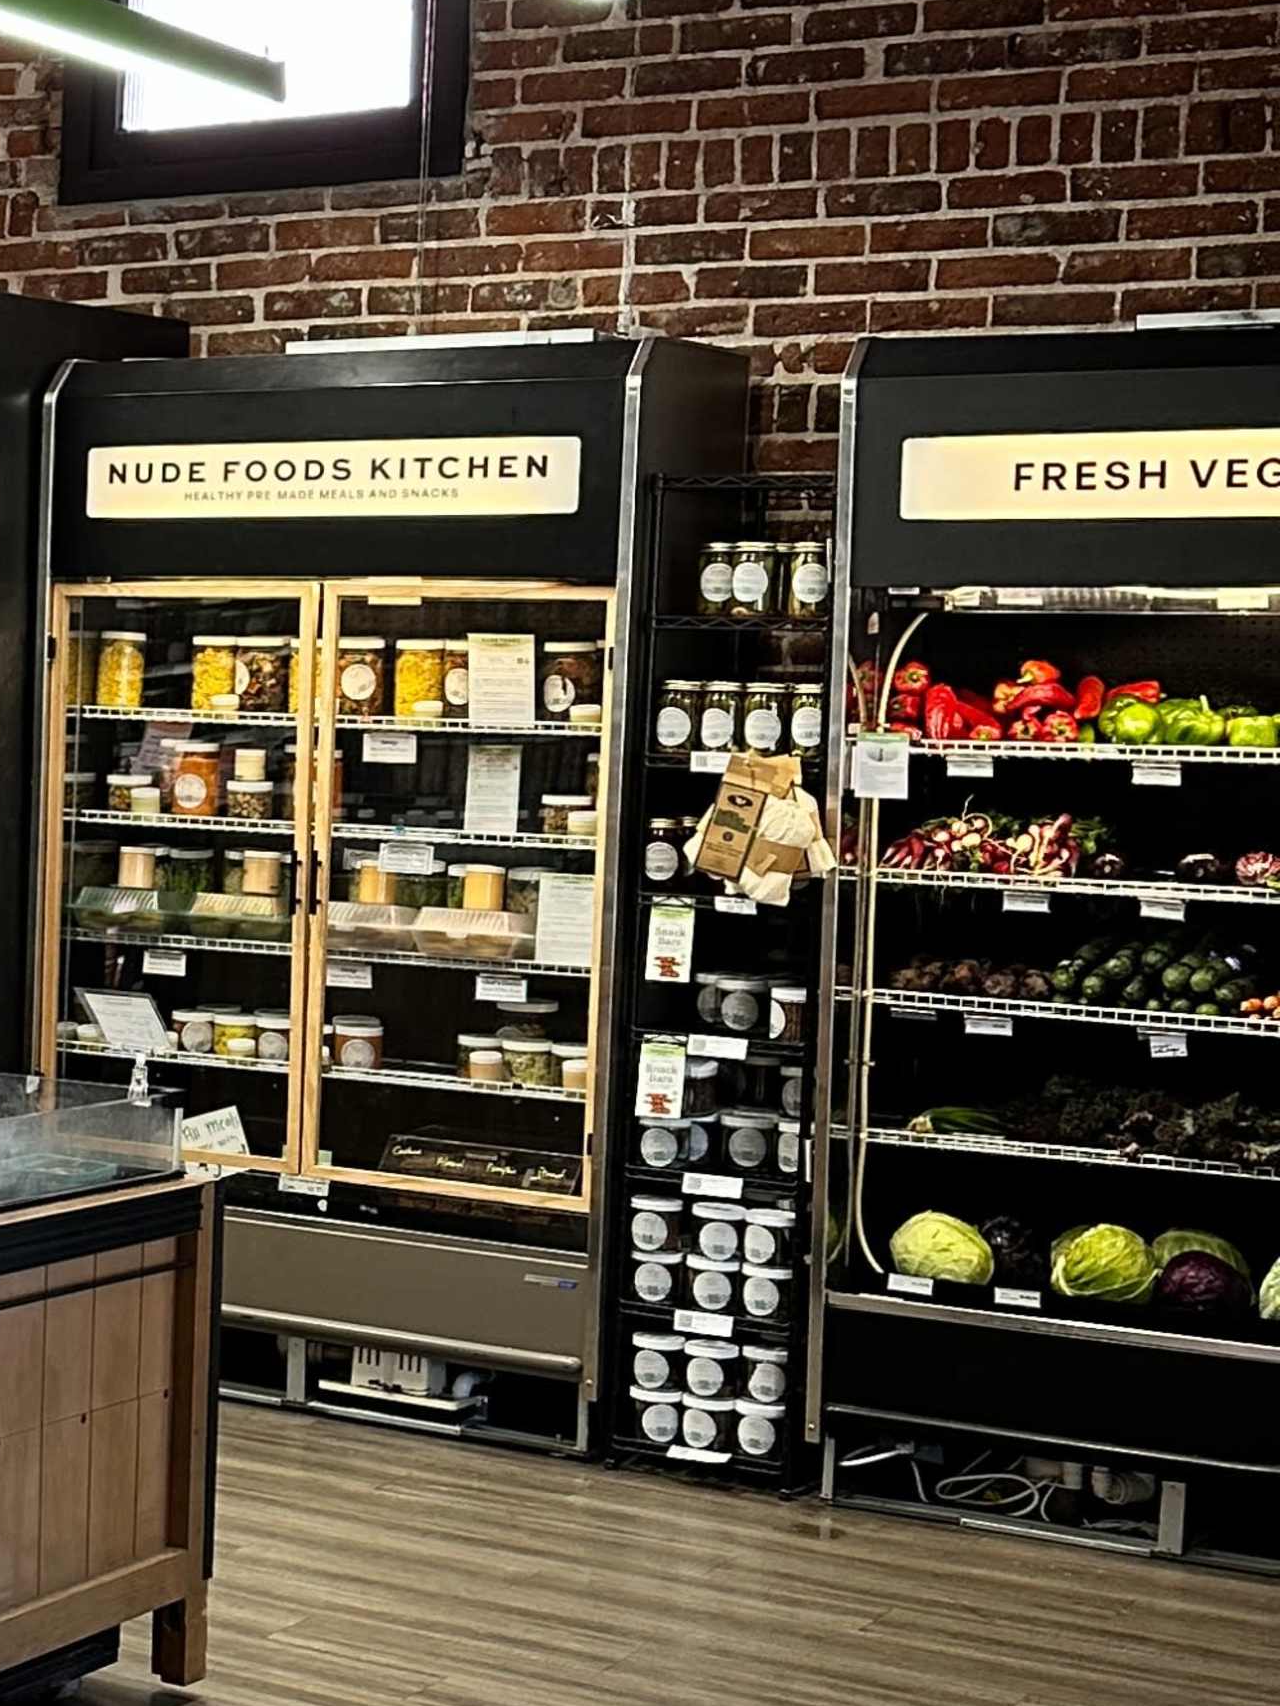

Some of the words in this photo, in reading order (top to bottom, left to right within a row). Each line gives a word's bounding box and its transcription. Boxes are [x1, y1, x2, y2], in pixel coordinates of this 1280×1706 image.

[108, 462, 207, 485] NUDE
[223, 457, 352, 483] FOODS
[370, 454, 550, 480] KITCHEN
[1012, 460, 1168, 492] FRESH
[1189, 456, 1280, 490] VEG
[184, 490, 243, 502] HEALTHY
[246, 490, 271, 501] PRE
[276, 489, 315, 501] MADE
[319, 488, 365, 500] MEALS
[367, 488, 398, 500] AND
[400, 487, 460, 499] SNACKS
